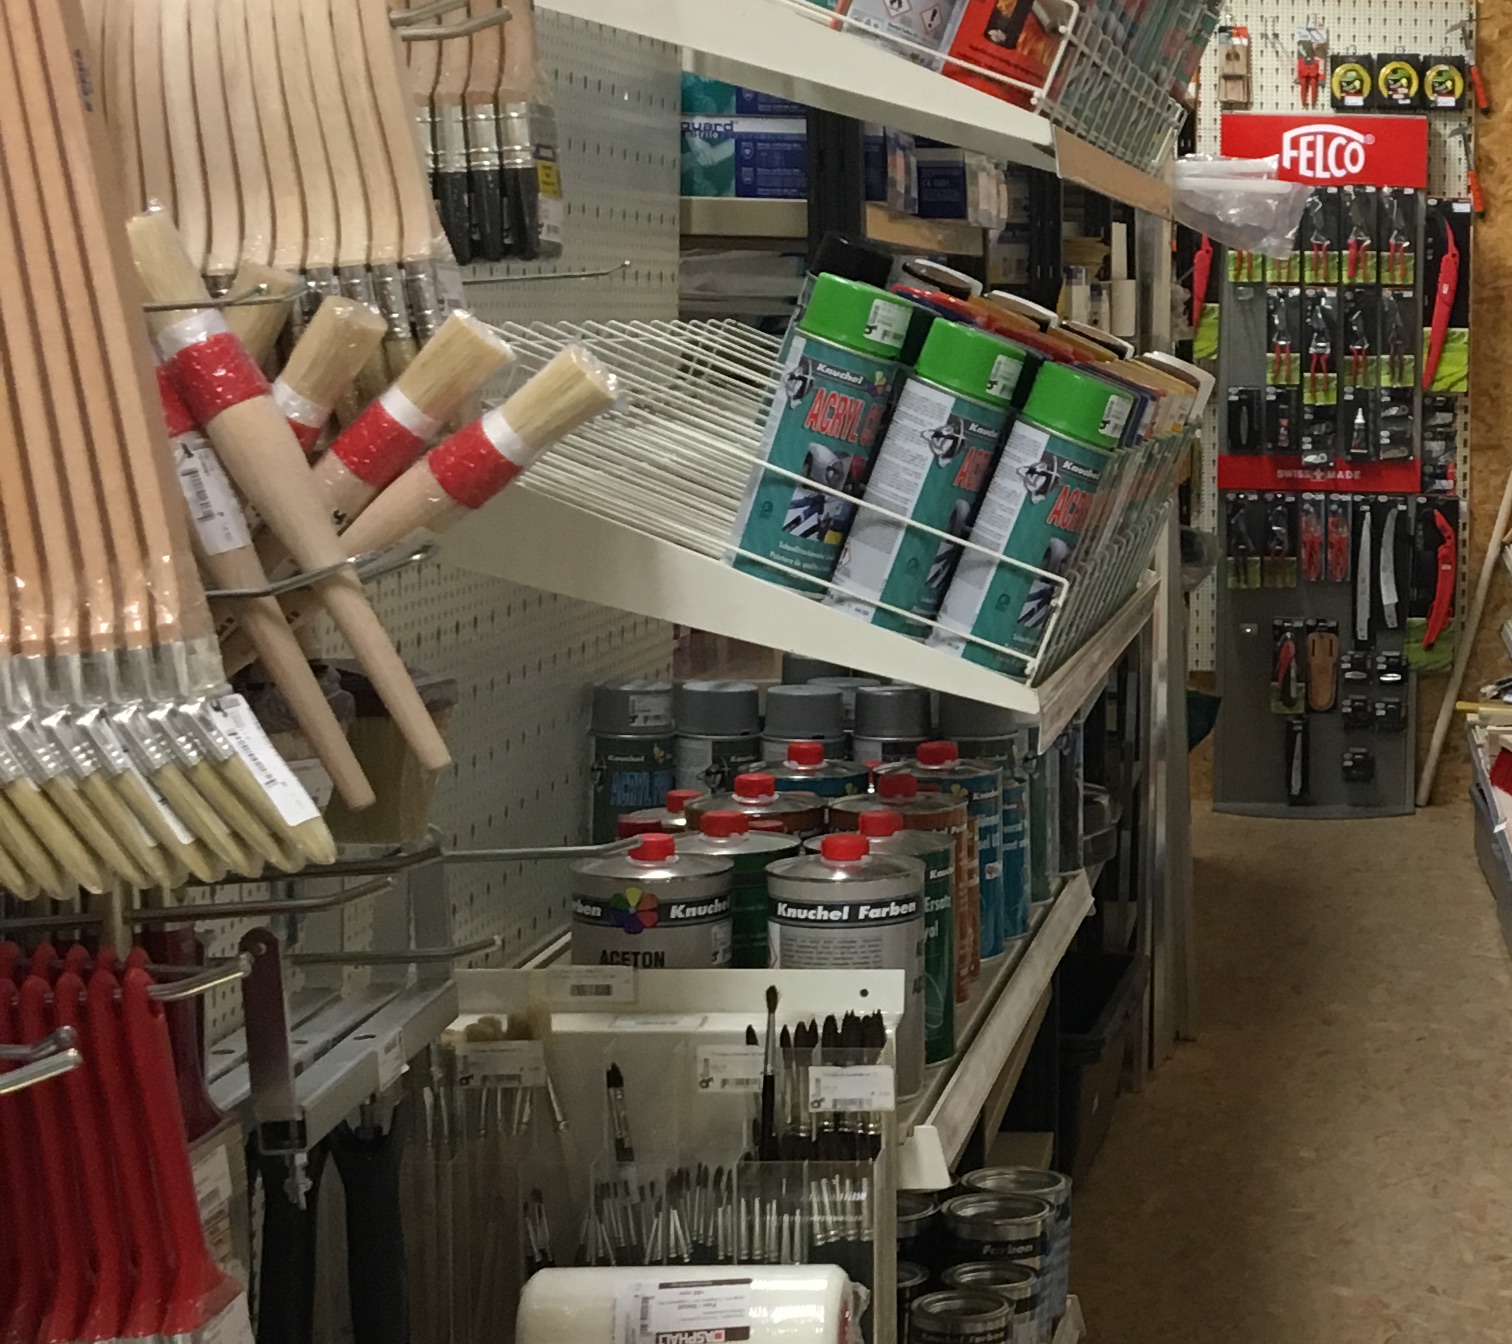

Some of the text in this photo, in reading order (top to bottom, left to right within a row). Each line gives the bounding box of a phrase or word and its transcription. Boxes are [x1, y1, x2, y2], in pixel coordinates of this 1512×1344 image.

[1282, 124, 1365, 178] FELCO
[816, 362, 864, 385] Knuchel
[777, 901, 916, 921] Knuchel Farben
[601, 949, 665, 969] ACETON
